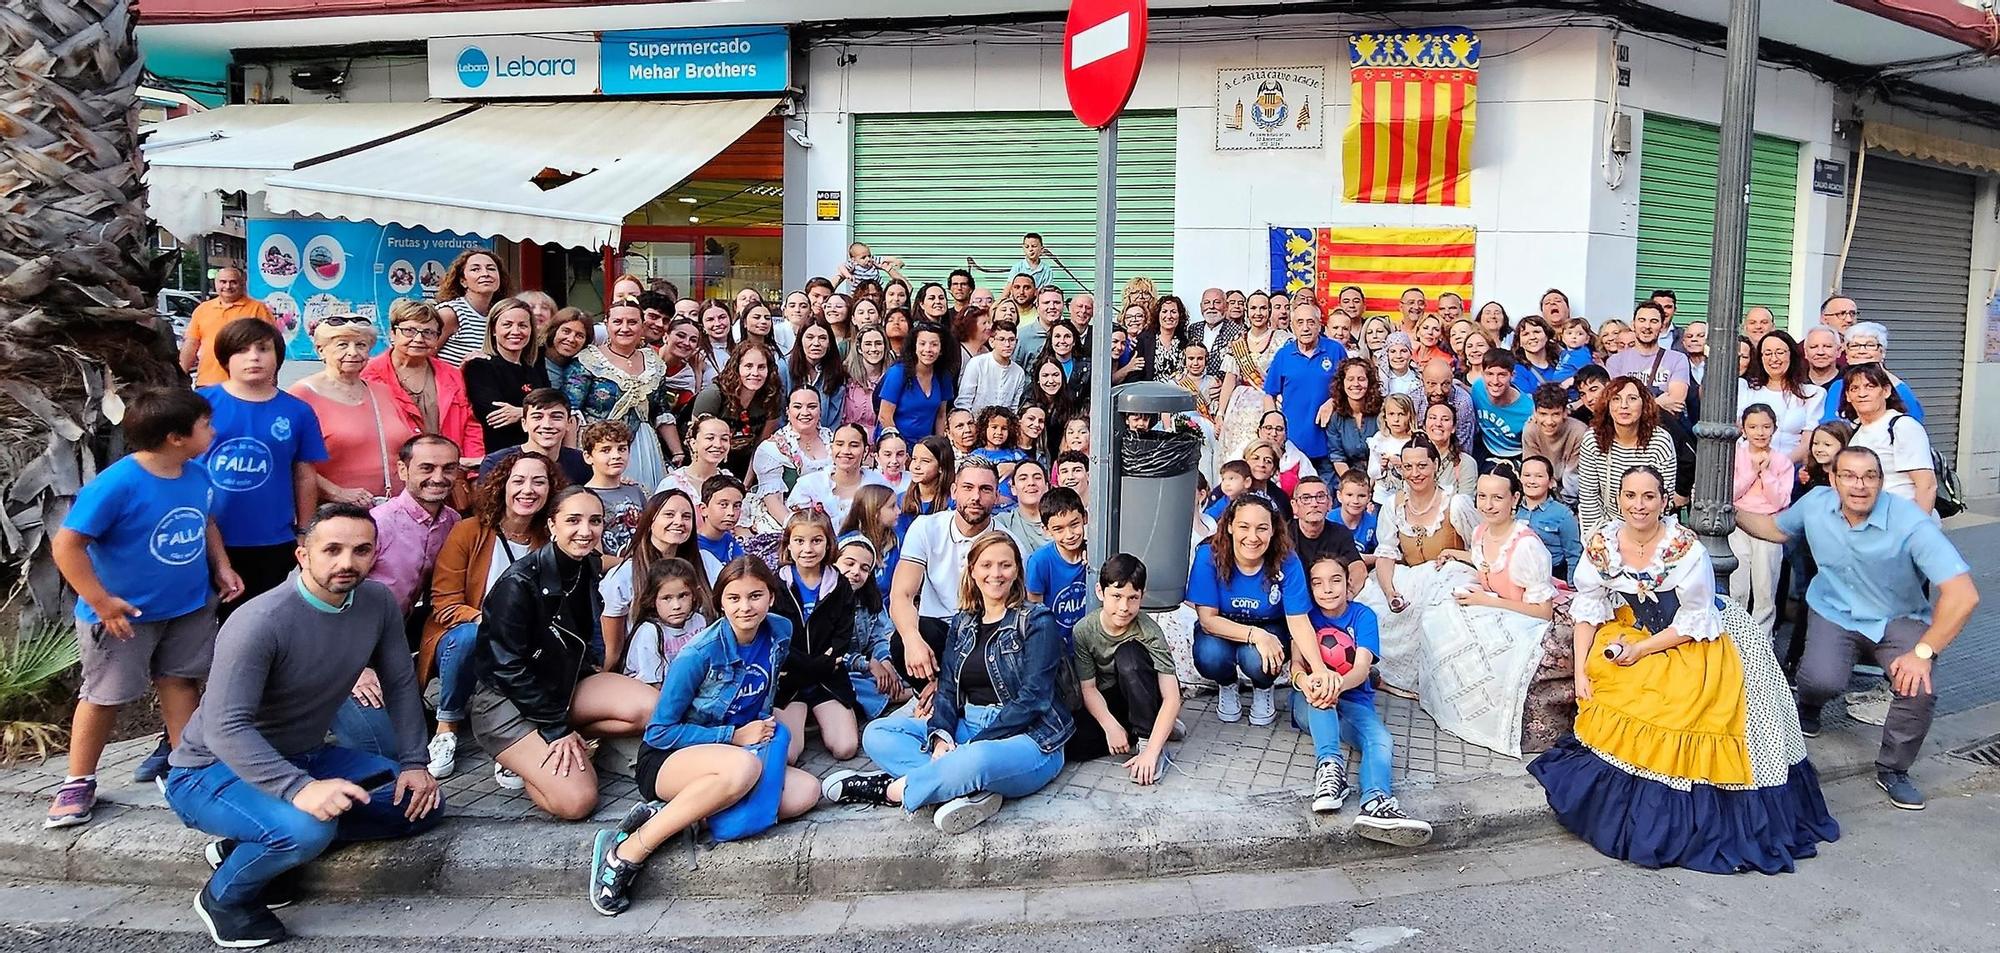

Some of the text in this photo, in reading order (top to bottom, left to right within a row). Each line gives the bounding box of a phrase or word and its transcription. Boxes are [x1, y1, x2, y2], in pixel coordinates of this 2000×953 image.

[628, 38, 751, 59] Supermercado
[458, 63, 489, 73] Lebara
[495, 55, 576, 77] Lebara
[629, 62, 757, 79] Mehar Brothers
[387, 237, 479, 250] Frutas y verduras
[215, 455, 267, 474] FALLA
[157, 526, 204, 550] FALLA
